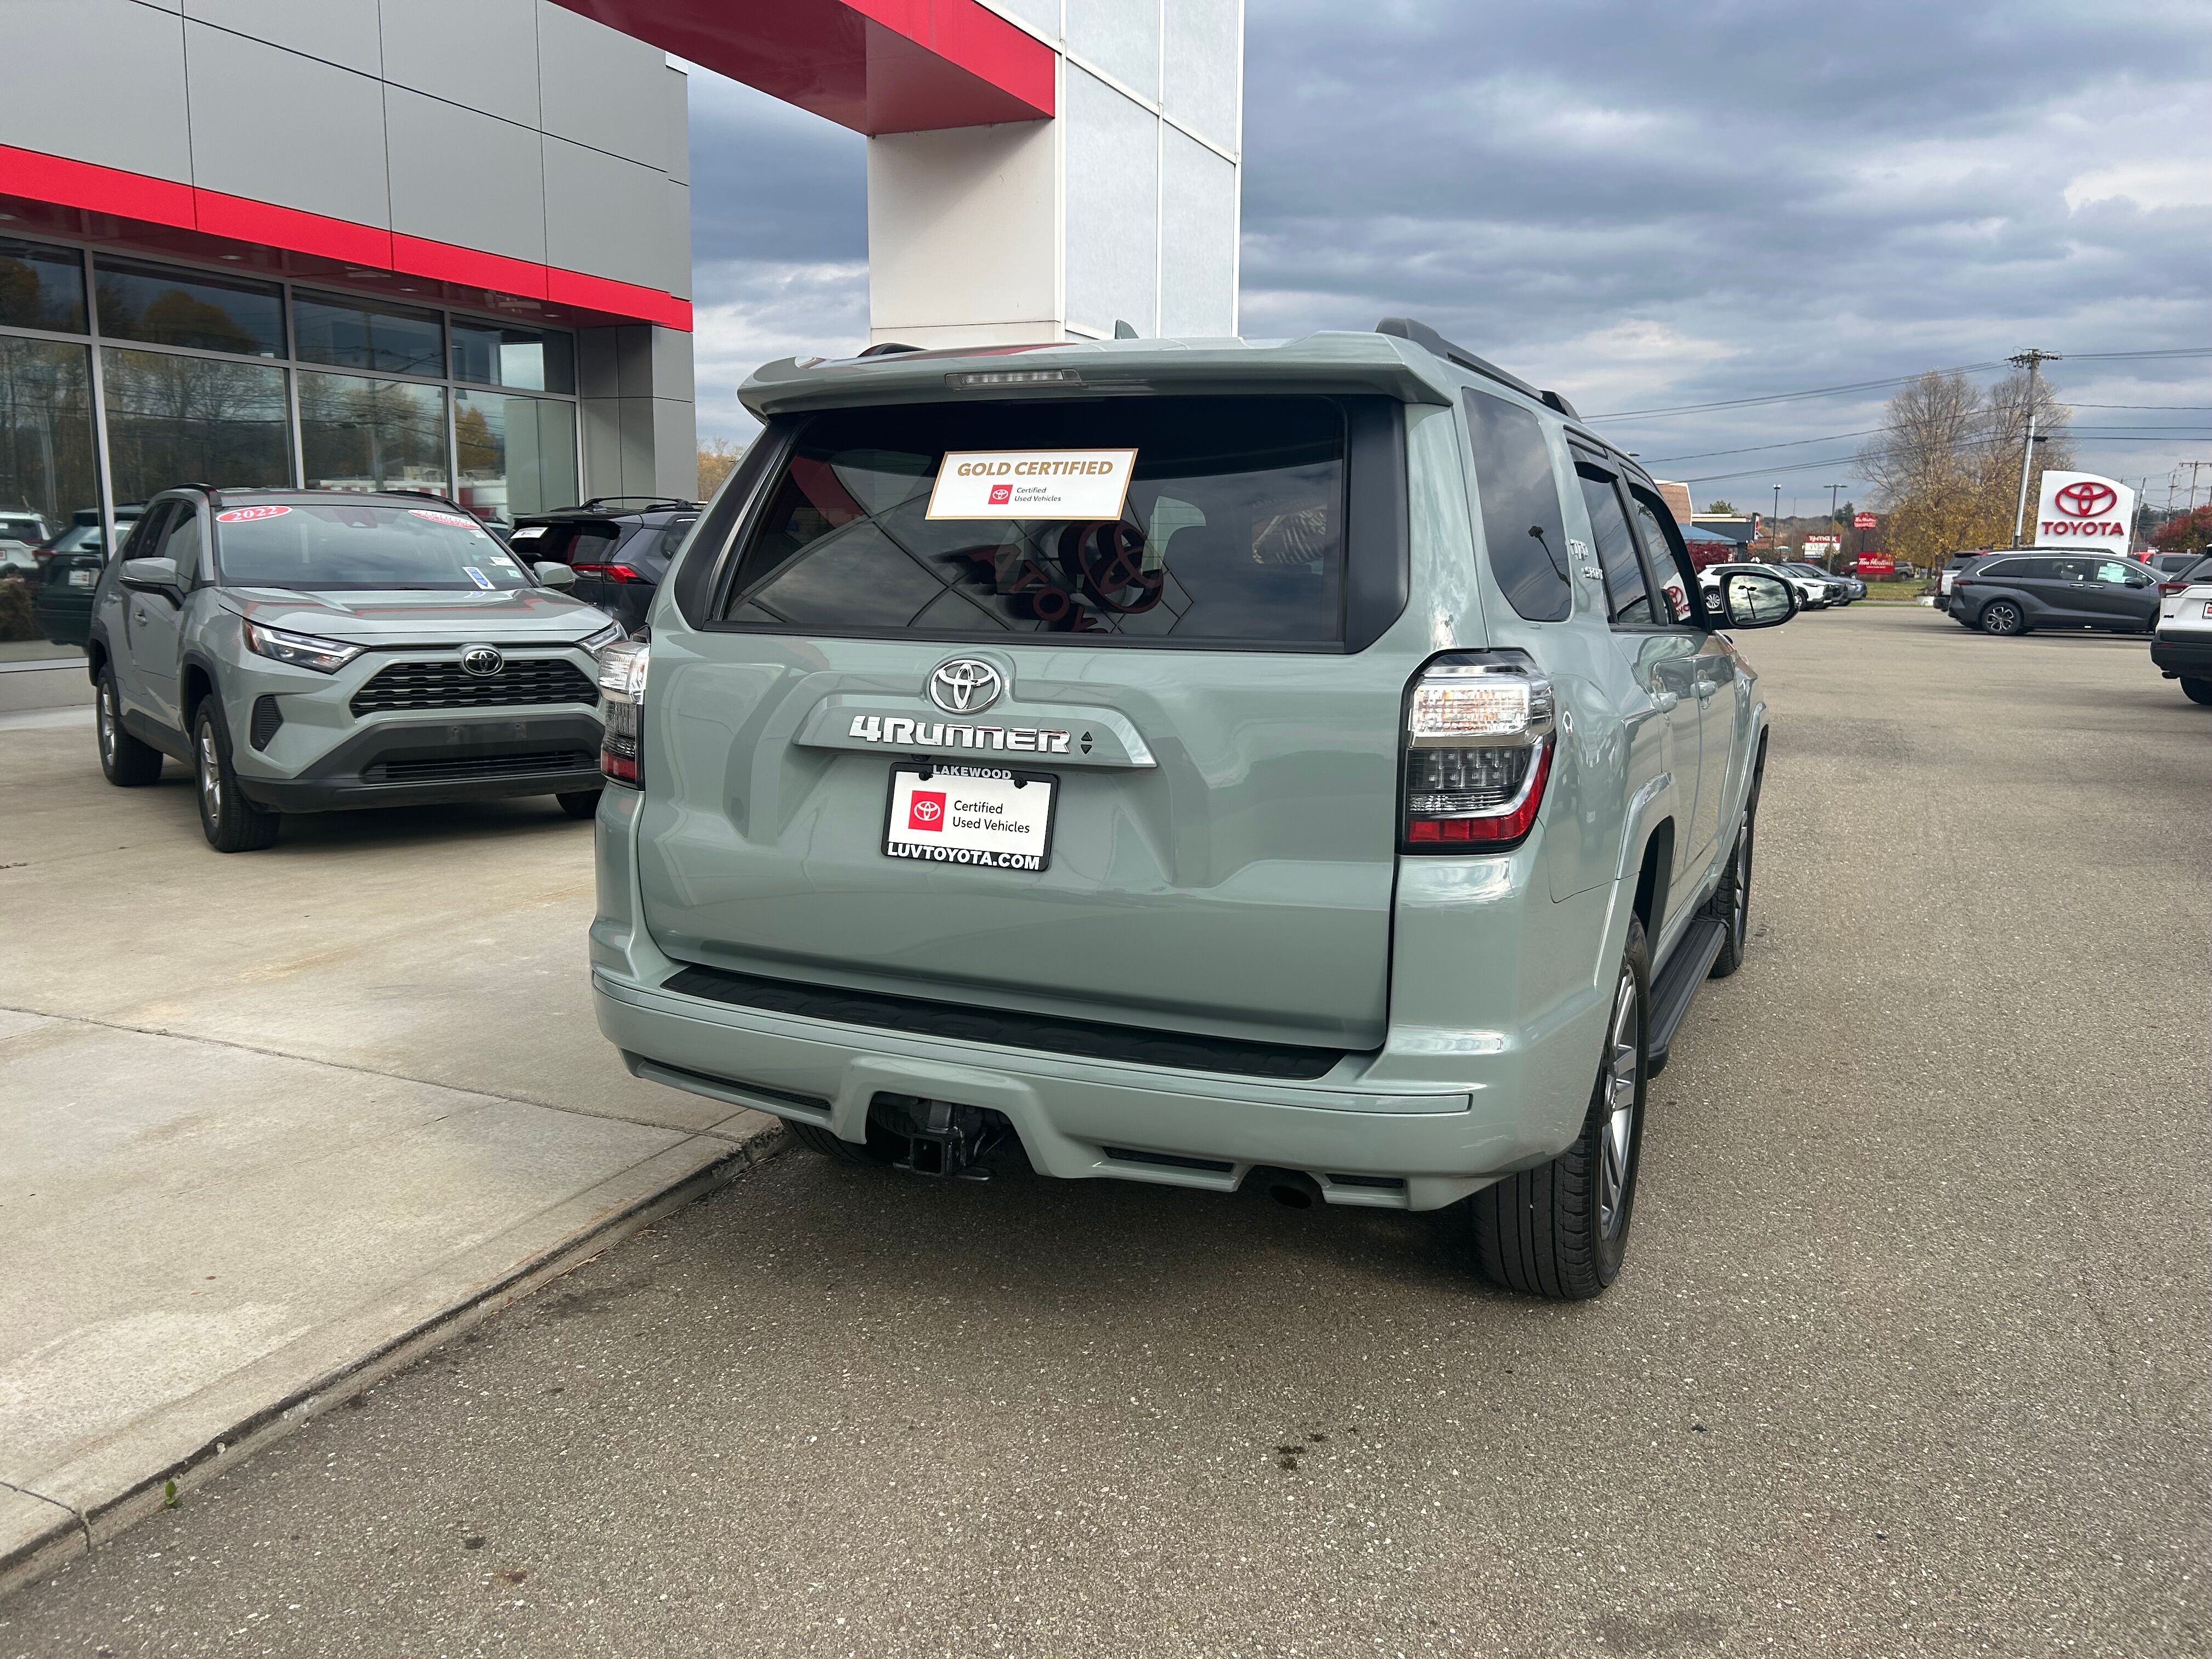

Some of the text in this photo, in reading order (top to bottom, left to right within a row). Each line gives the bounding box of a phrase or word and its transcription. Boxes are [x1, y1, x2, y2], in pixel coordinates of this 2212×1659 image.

[957, 461, 1113, 476] GOLD CERTIFIED
[232, 506, 278, 521] 2022
[2041, 521, 2124, 535] TOYOTA
[932, 764, 1012, 780] LAKEWOOD
[954, 800, 1003, 814] Certified
[952, 816, 1030, 833] Used Vehicles
[888, 842, 1040, 870] LUVTOYOTA.COM
